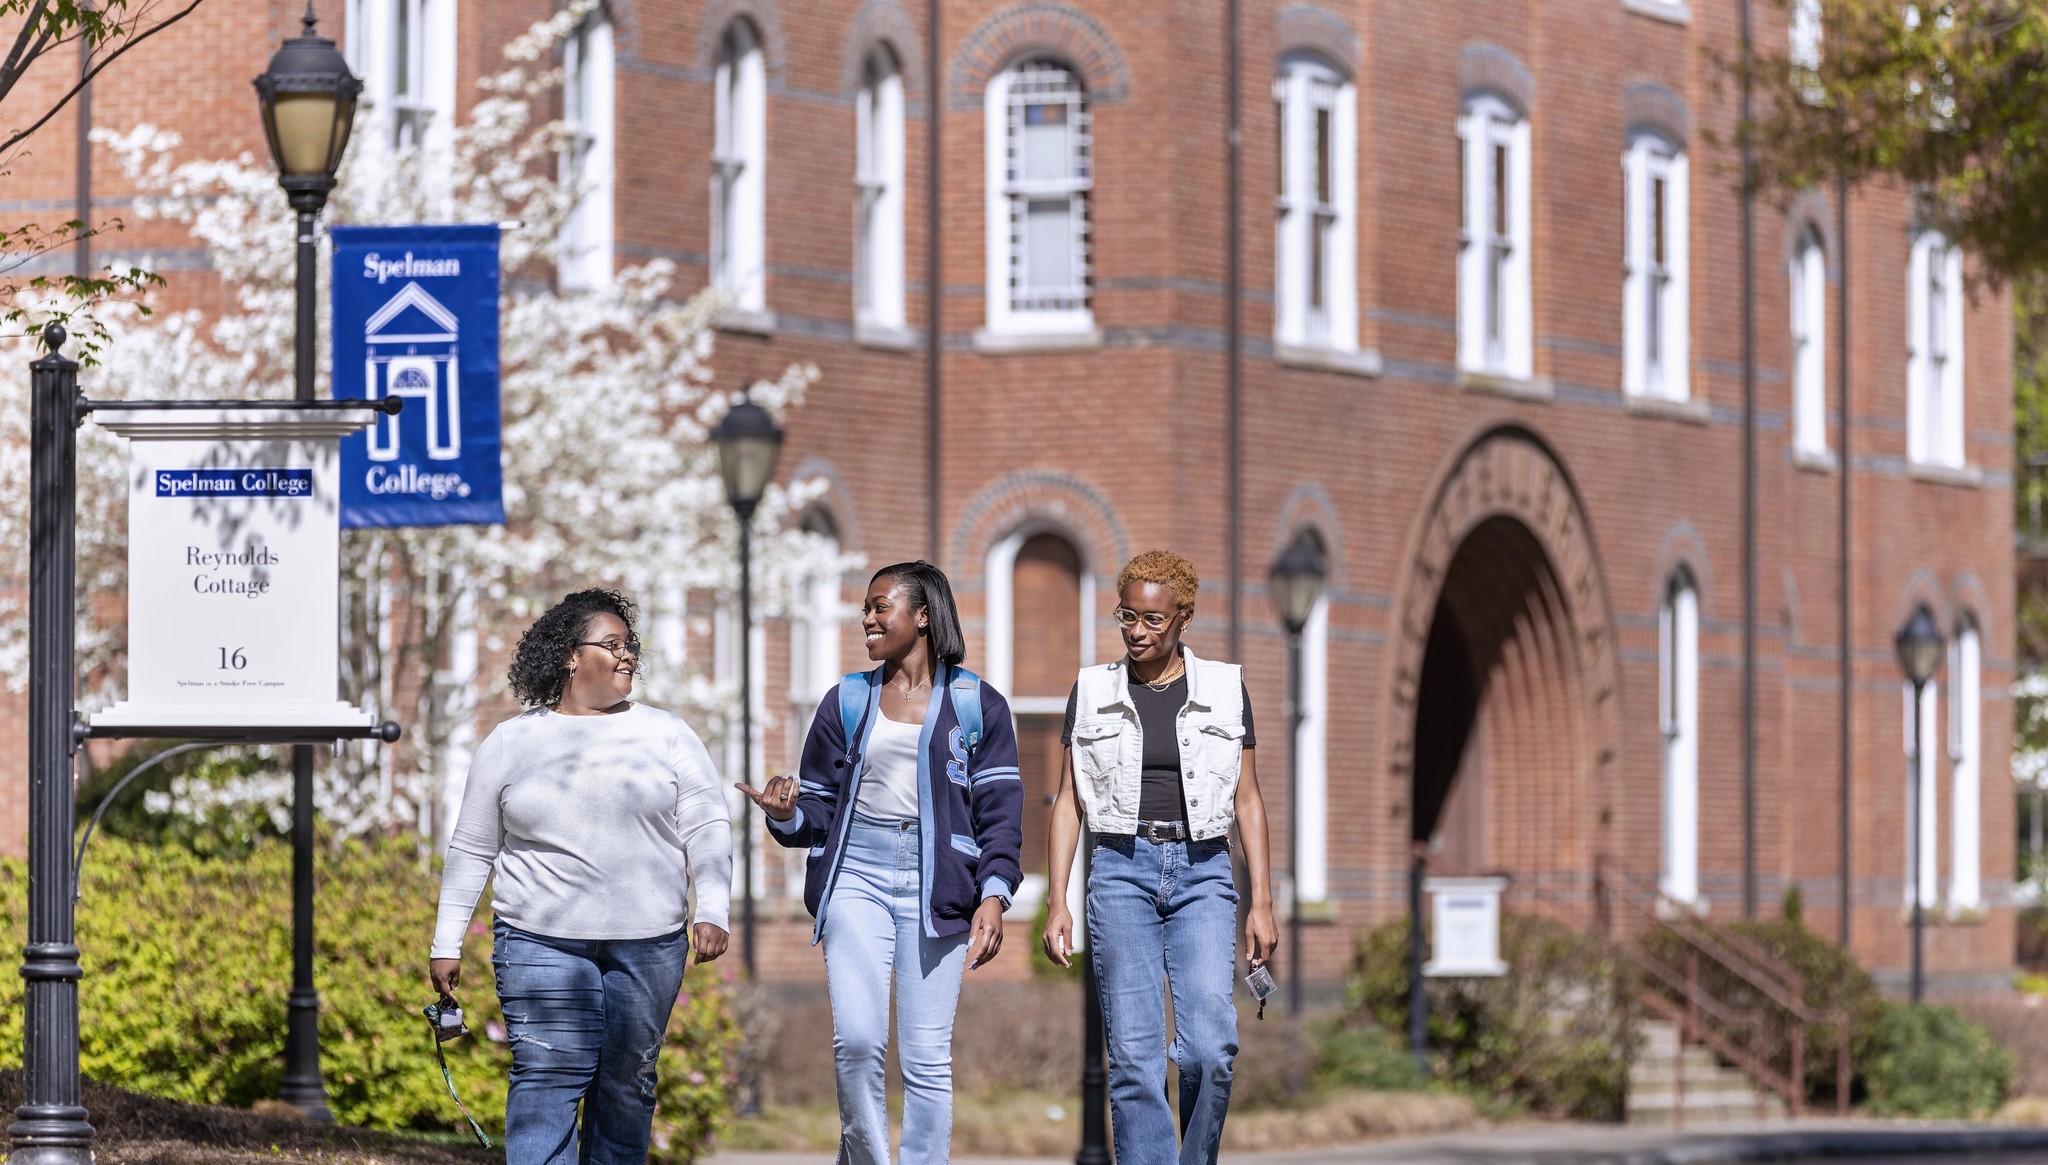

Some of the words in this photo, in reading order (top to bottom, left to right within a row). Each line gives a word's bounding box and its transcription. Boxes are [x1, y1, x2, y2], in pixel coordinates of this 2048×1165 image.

[363, 251, 461, 284] Spelman
[159, 472, 236, 495] Spelman
[241, 472, 309, 495] College
[186, 545, 279, 571] Reynolds
[194, 574, 270, 599] Cottage
[217, 646, 247, 670] 16
[176, 680, 204, 688] Spelman
